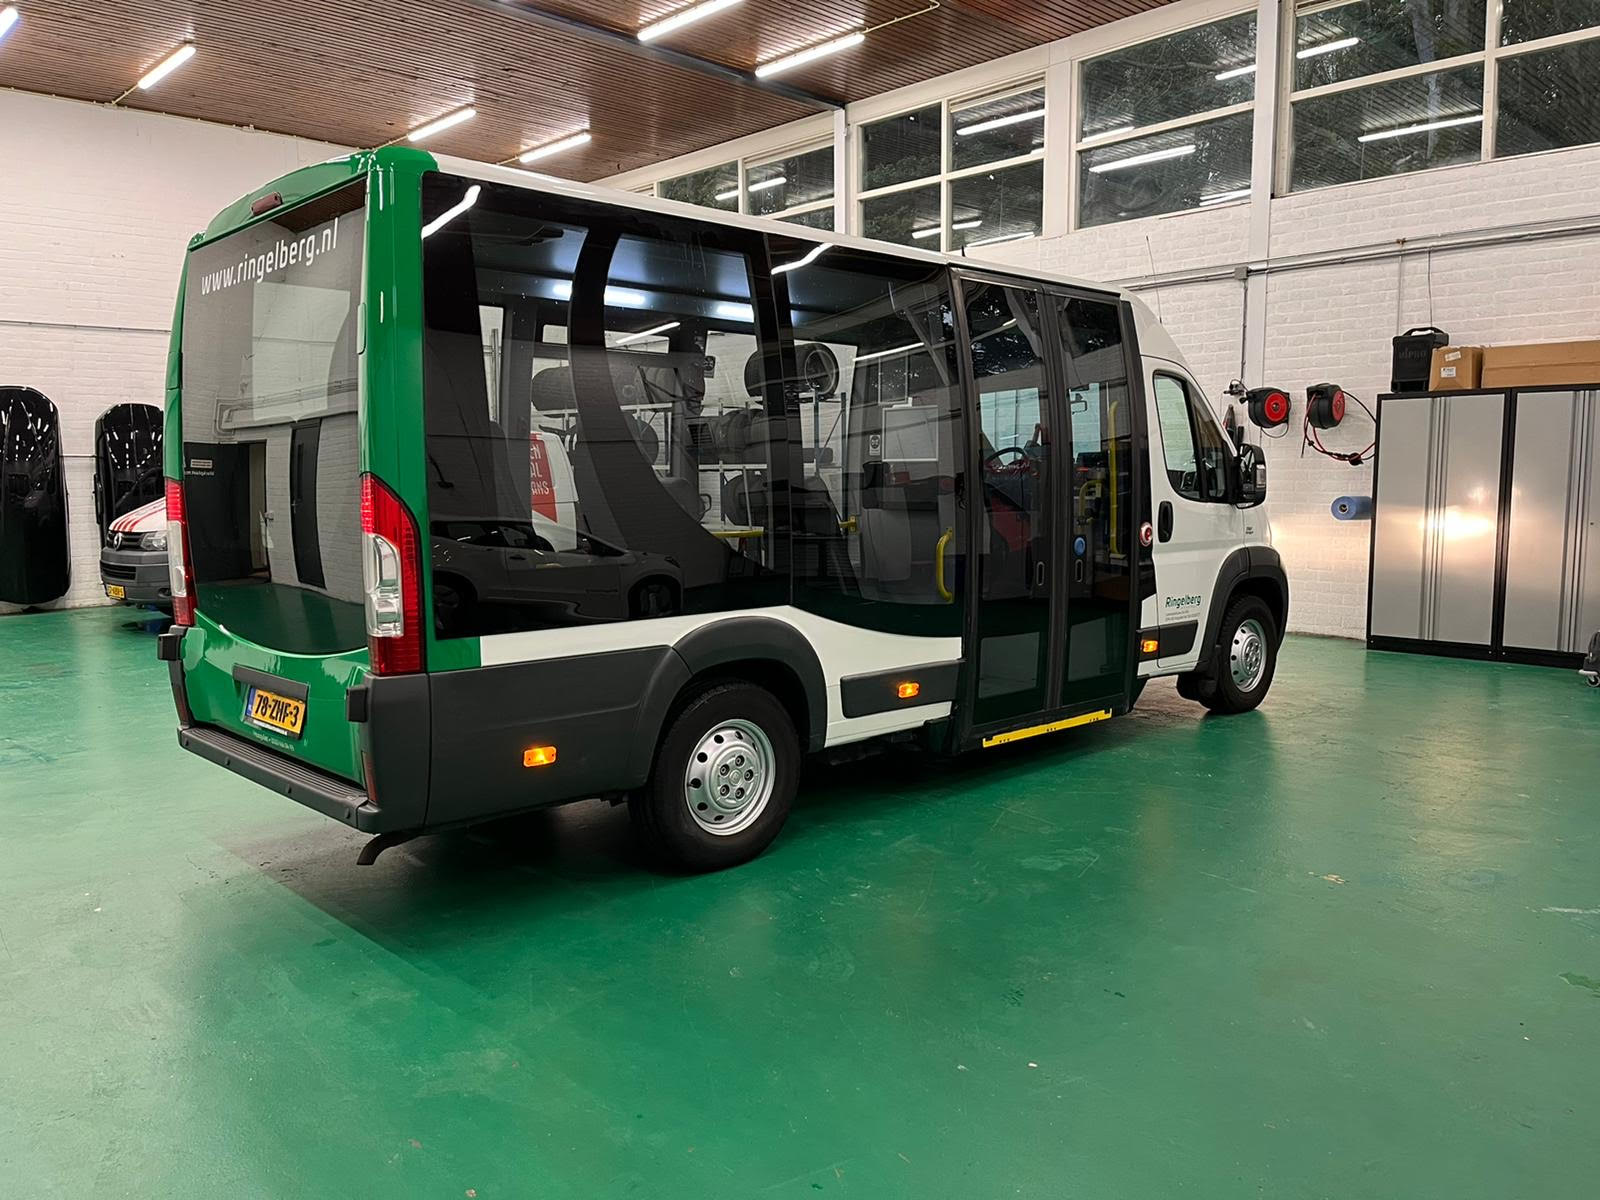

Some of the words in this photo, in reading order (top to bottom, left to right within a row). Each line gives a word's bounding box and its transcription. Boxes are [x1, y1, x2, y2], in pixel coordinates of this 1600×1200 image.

[201, 217, 338, 295] www.ringelberg.nl
[530, 444, 542, 460] EN
[530, 462, 543, 478] AL
[530, 480, 550, 496] ANS
[1165, 594, 1201, 609] Ringelberg
[255, 694, 300, 727] 78-ZHF-3
